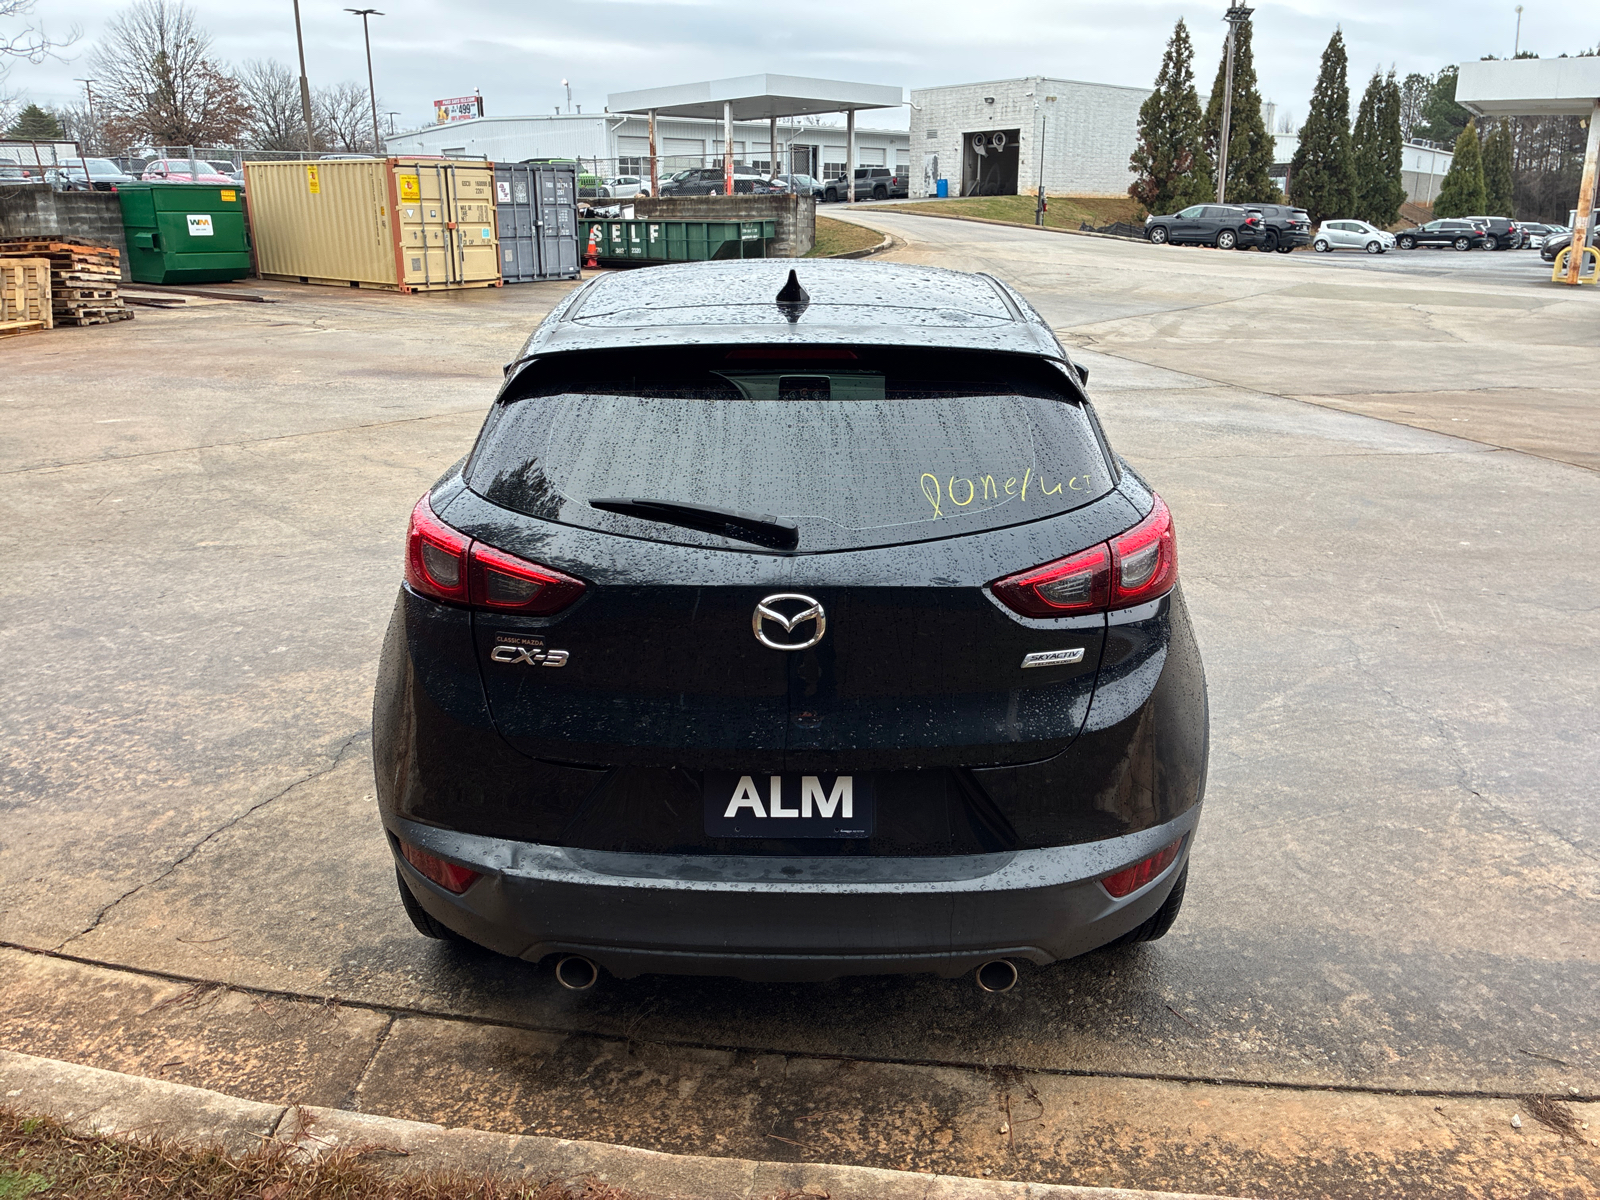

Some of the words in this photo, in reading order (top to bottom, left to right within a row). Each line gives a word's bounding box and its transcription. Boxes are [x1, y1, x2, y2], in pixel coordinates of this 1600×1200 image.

[496, 636, 521, 644] CLASSIC
[521, 638, 544, 646] MAZDA
[490, 645, 570, 667] CX-3
[1030, 651, 1080, 661] SKYACTIV
[723, 775, 853, 818] ALM
